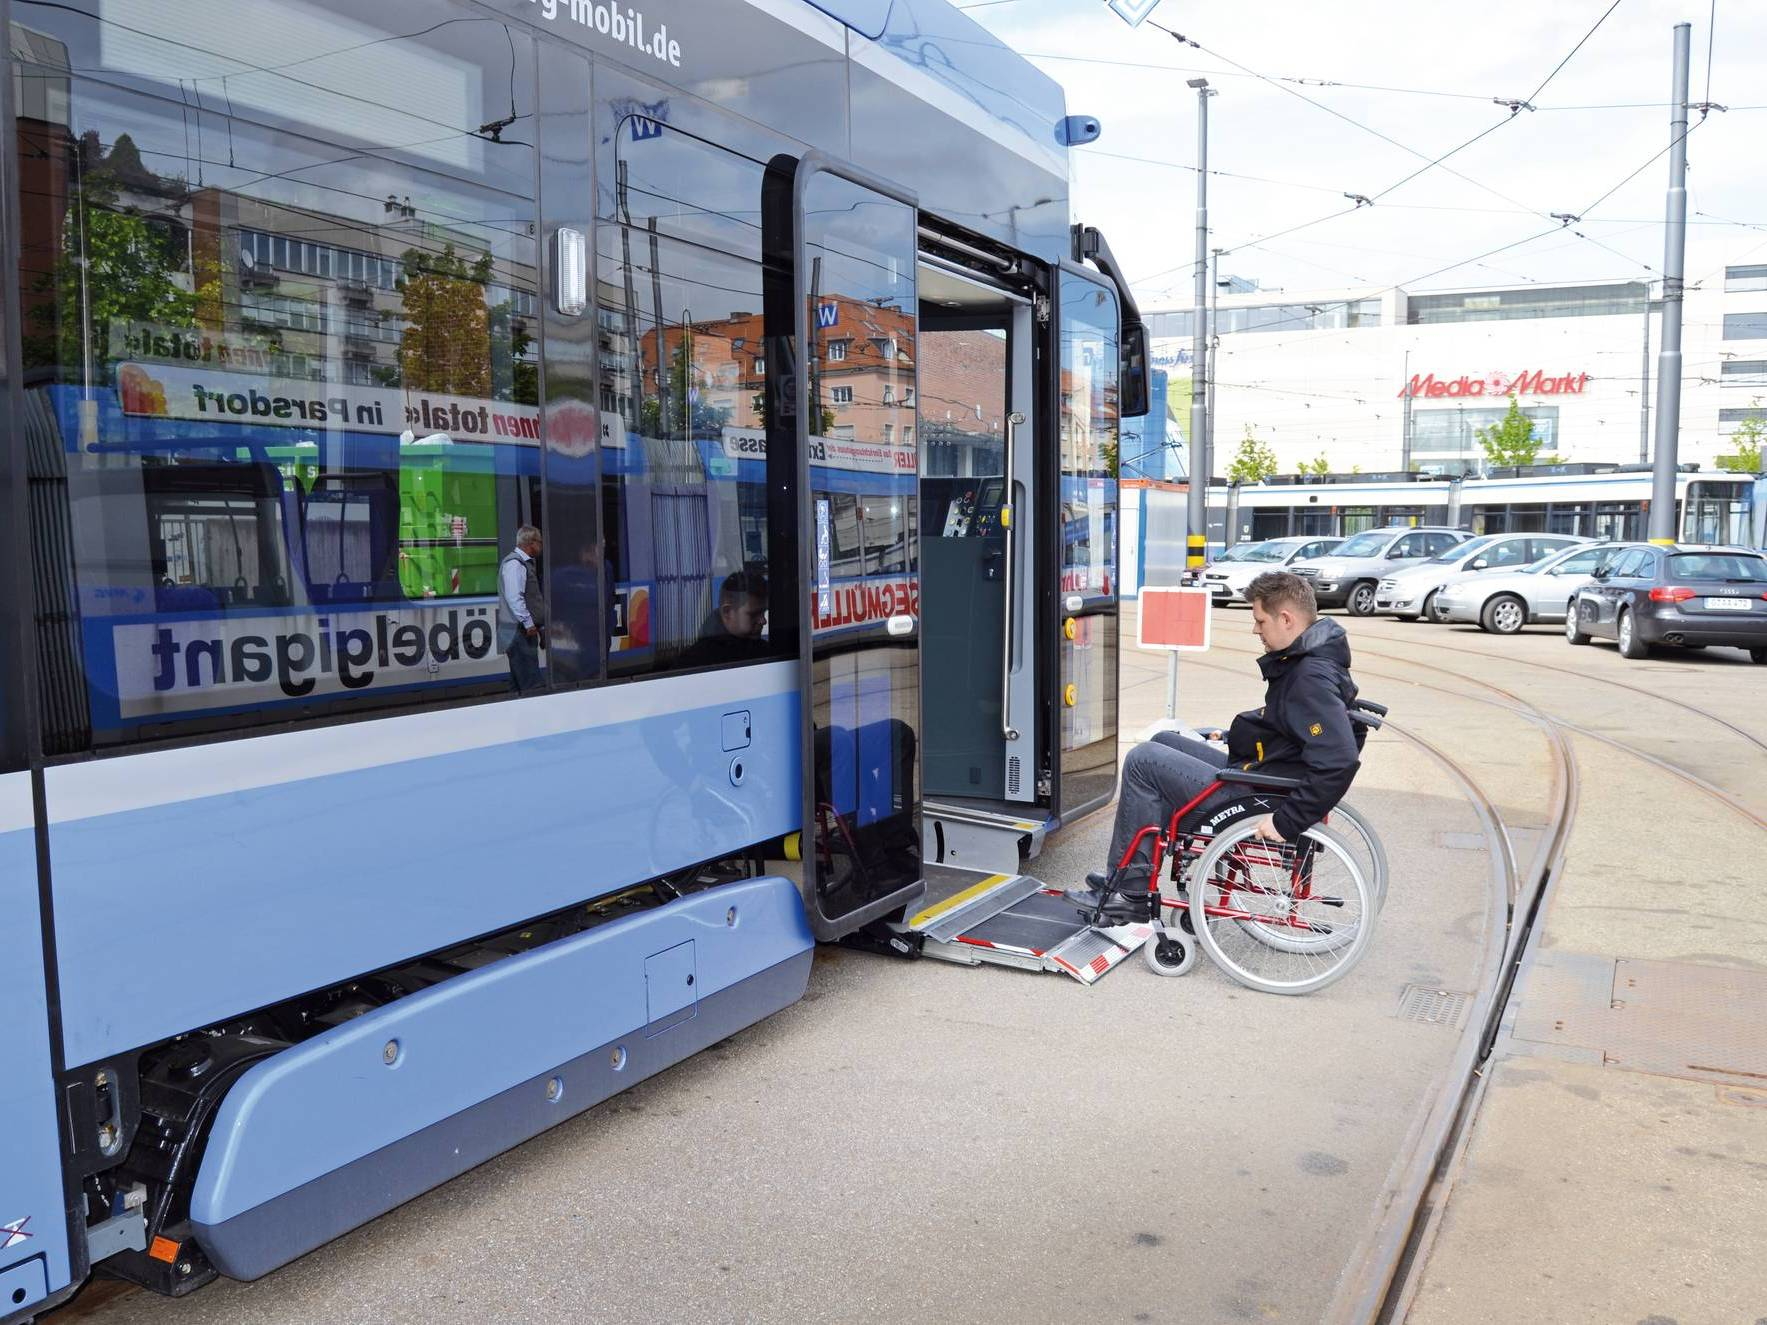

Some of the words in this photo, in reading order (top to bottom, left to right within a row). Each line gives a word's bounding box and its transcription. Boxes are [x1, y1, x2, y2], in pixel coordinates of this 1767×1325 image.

[529, 0, 681, 67] g-mobil.de
[1397, 372, 1486, 398] Media
[1505, 369, 1587, 395] Markt
[1209, 804, 1246, 827] MEYRA
